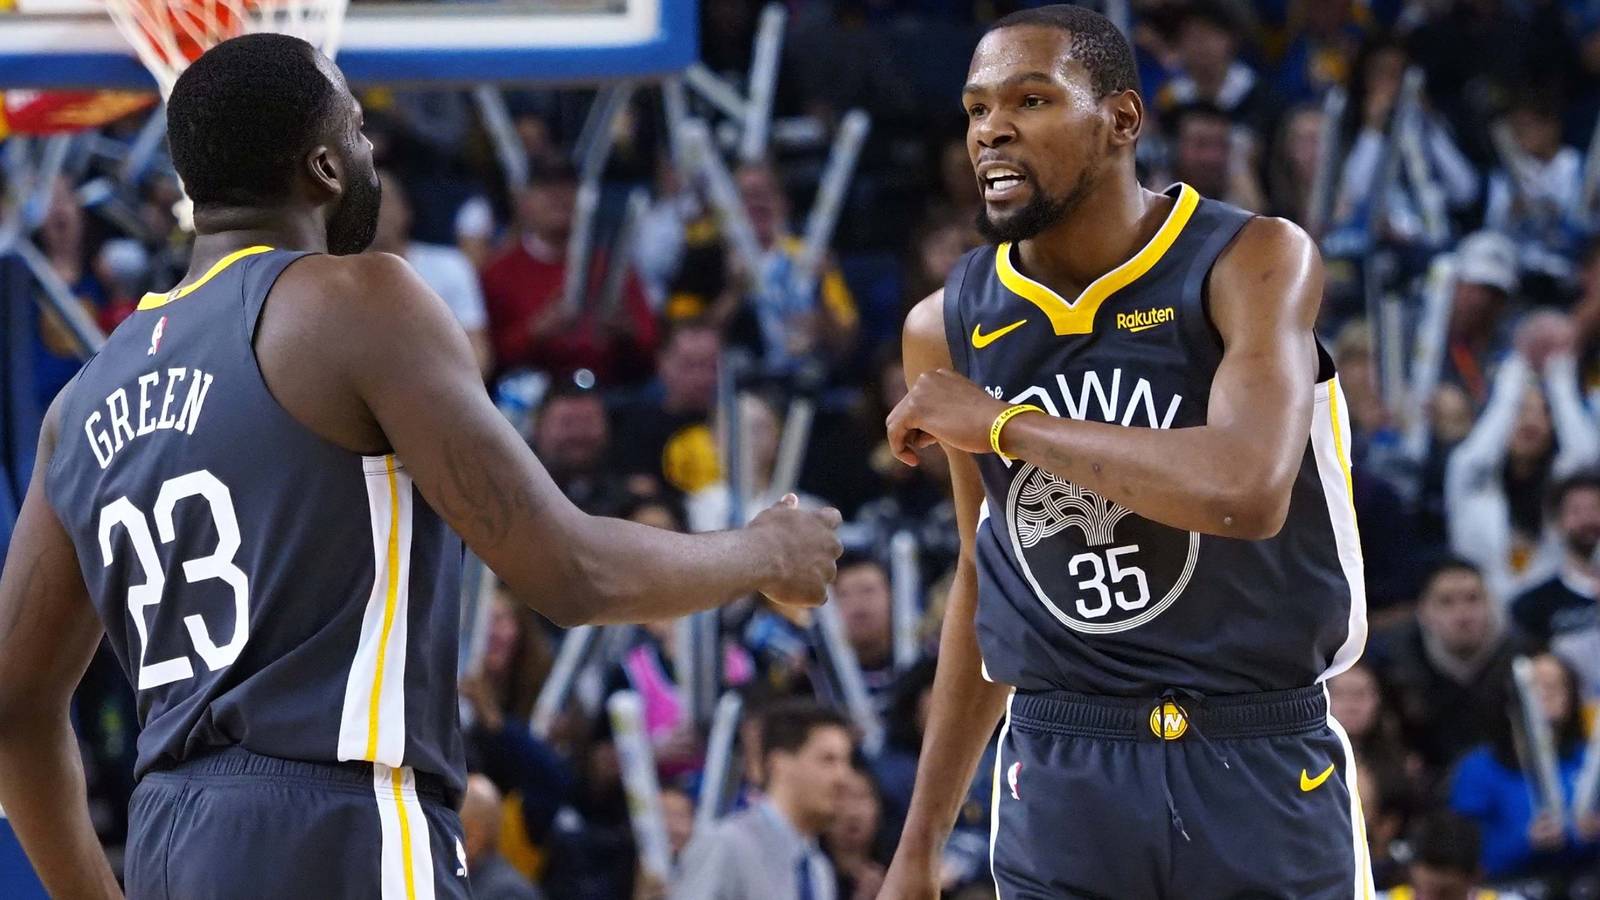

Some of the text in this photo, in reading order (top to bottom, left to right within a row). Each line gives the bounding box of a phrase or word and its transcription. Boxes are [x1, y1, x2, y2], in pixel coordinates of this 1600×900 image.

[1116, 306, 1175, 330] Rakuten
[84, 367, 214, 469] GREEN
[98, 469, 249, 690] 23
[1068, 544, 1151, 619] 35
[1154, 713, 1184, 732] W
